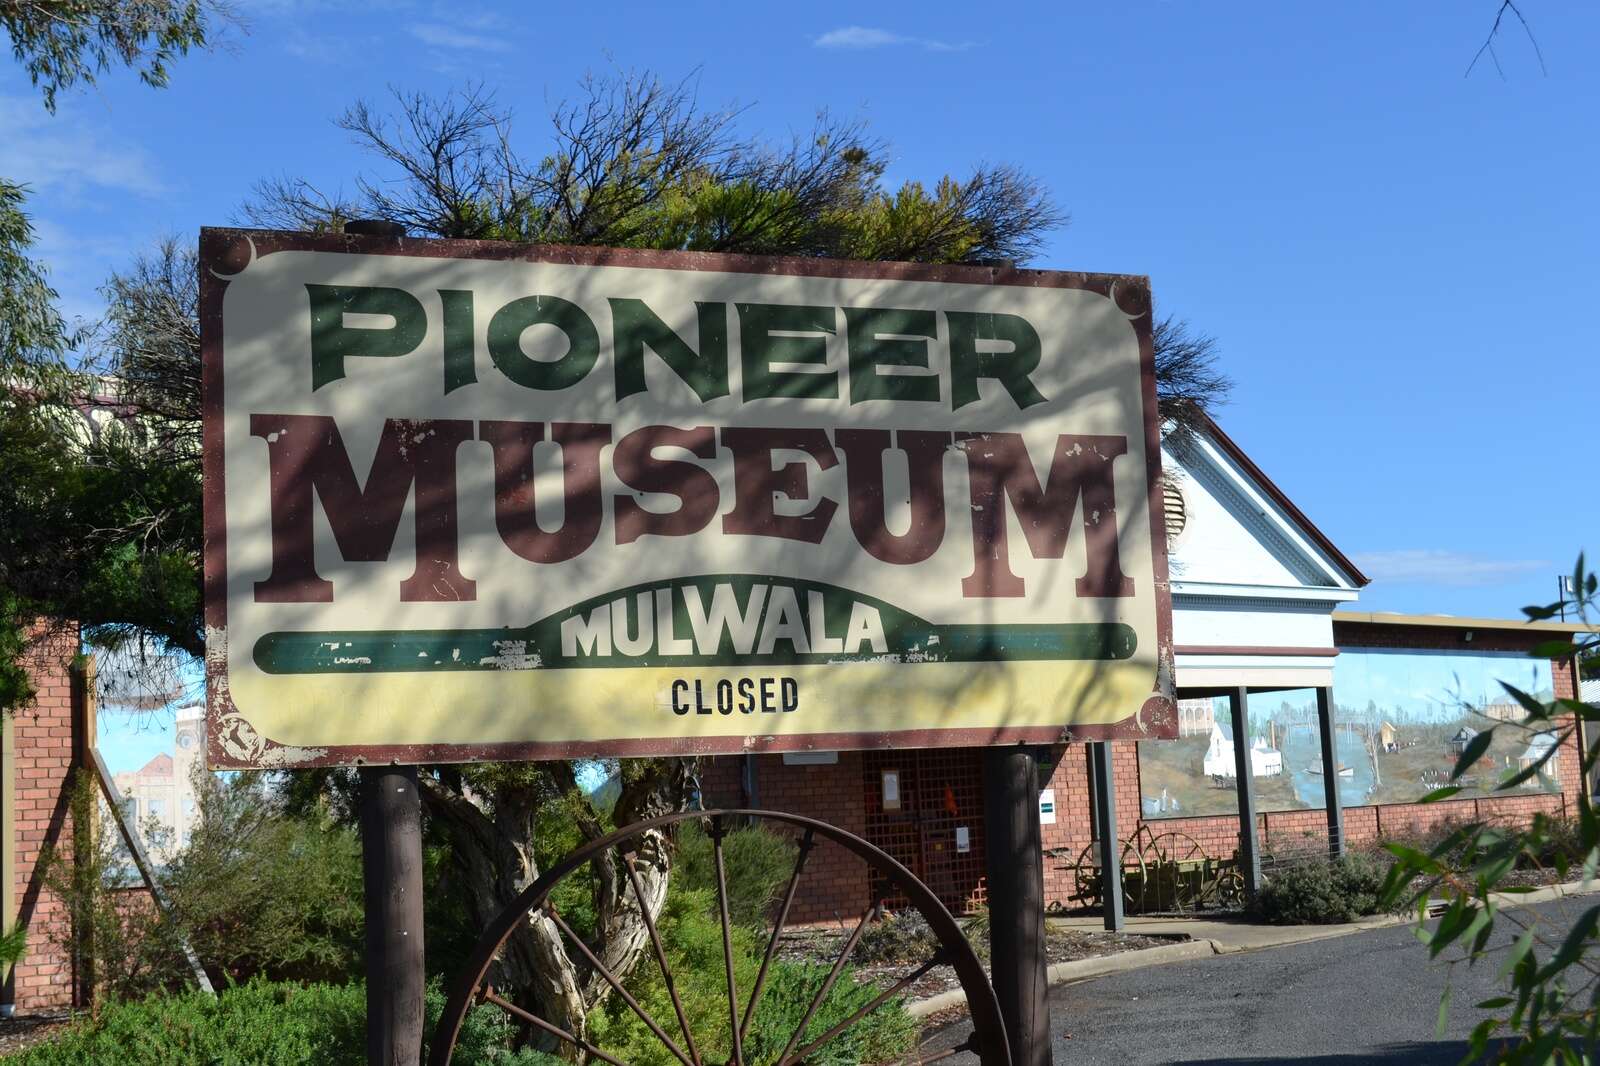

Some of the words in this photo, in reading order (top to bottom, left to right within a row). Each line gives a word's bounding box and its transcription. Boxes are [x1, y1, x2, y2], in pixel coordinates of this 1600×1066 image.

[304, 283, 1049, 411] PIONEER
[250, 413, 1136, 602] MUSEUM
[562, 583, 888, 657] MULWALA
[672, 677, 799, 716] CLOSED
